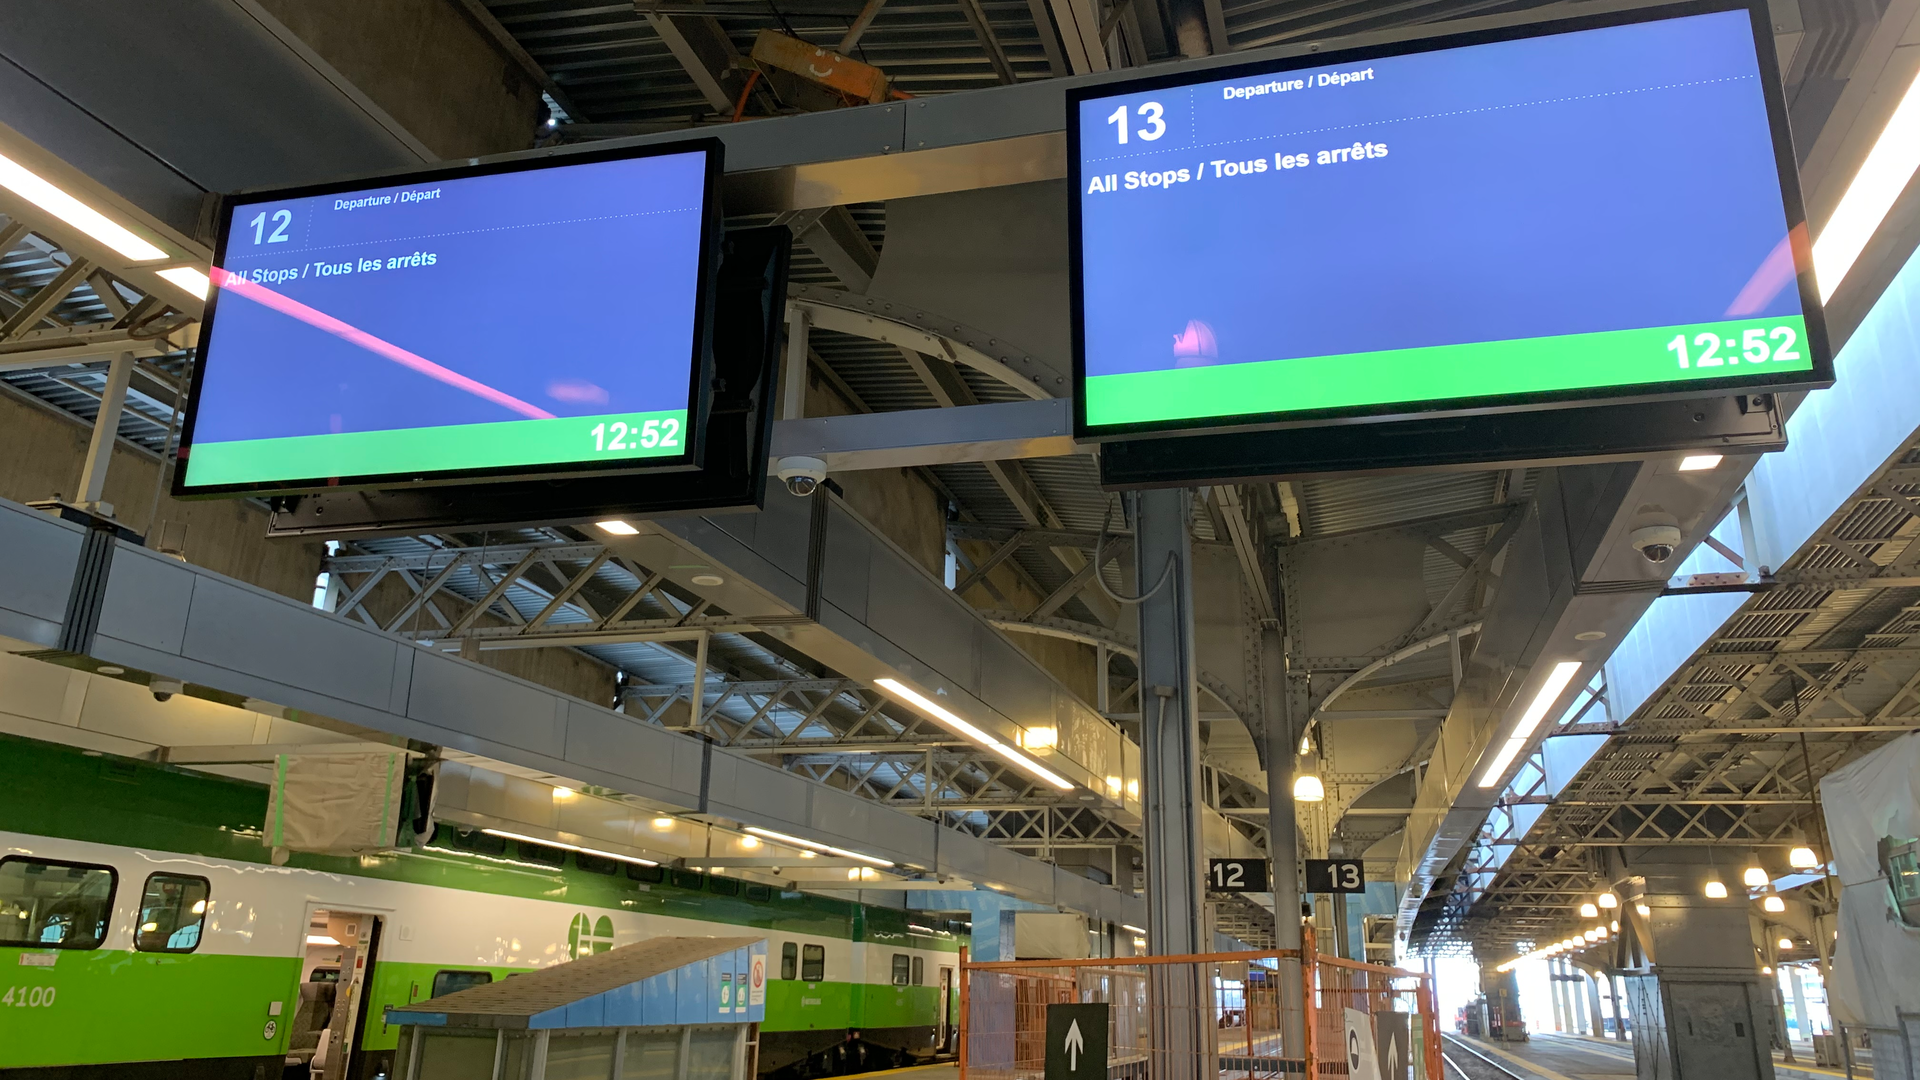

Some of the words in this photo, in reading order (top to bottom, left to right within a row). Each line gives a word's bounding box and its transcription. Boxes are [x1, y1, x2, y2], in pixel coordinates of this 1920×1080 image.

[1223, 79, 1304, 100] Departure
[1307, 75, 1314, 88] /
[1317, 68, 1374, 87] Départ
[1107, 101, 1167, 145] 13
[1087, 174, 1118, 195] All
[1124, 166, 1191, 190] Stops
[1196, 162, 1205, 181] /
[1210, 158, 1268, 178] Tous
[1274, 152, 1310, 170] les
[1316, 141, 1389, 165] arrêts
[334, 195, 391, 211] Departure
[393, 192, 399, 203] /
[401, 188, 441, 203] Départ
[250, 209, 292, 245] 12
[223, 269, 248, 288] All
[251, 267, 299, 285] Stops
[301, 263, 310, 279] /
[313, 261, 353, 278] Tous
[357, 257, 382, 273] les
[386, 251, 437, 270] arrêts
[1667, 325, 1801, 369] 12:52
[591, 417, 680, 453] 12:52
[1213, 862, 1245, 887] 12
[1327, 863, 1361, 889] 13
[1, 985, 56, 1007] 4100
